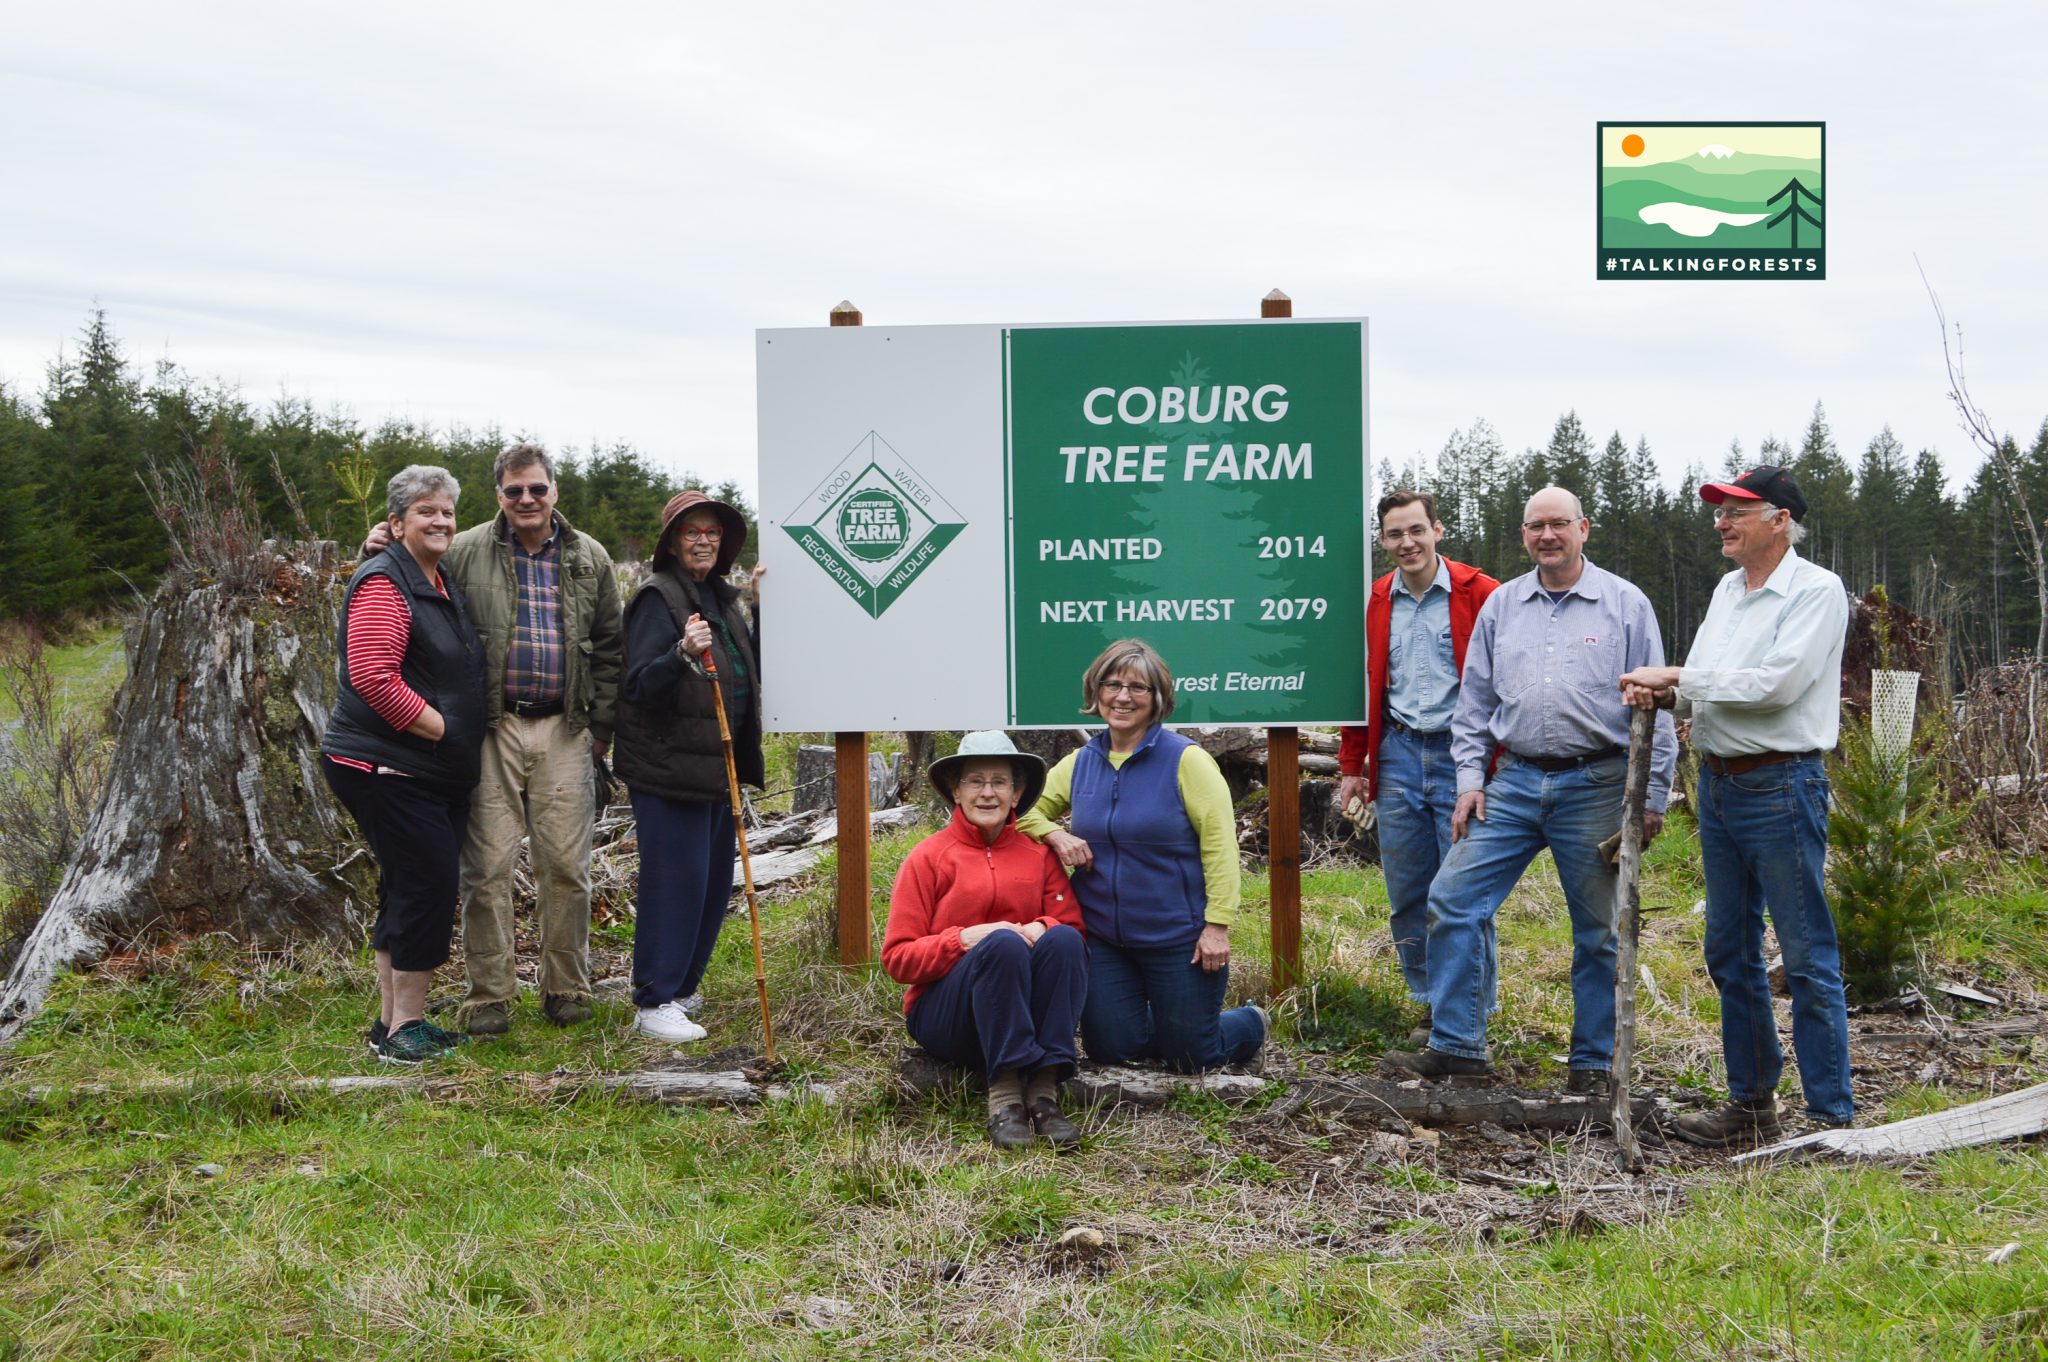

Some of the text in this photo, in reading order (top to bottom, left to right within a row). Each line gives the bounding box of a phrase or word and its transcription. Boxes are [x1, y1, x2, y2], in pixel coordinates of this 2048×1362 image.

[1083, 384, 1289, 425] COBURG
[1059, 443, 1313, 483] TREE FARM
[818, 470, 851, 504] WOOD
[894, 468, 932, 506] WATER
[846, 508, 898, 524] TREE
[850, 500, 894, 508] CERTIFIED
[844, 524, 901, 541] FARM
[1039, 535, 1326, 561] PLANTED 2014
[800, 533, 866, 599] RECREATION
[888, 541, 936, 589] WILDLIFE
[1040, 597, 1328, 623] NEXT HARVEST 2079
[1173, 671, 1305, 692] rest Eternal
